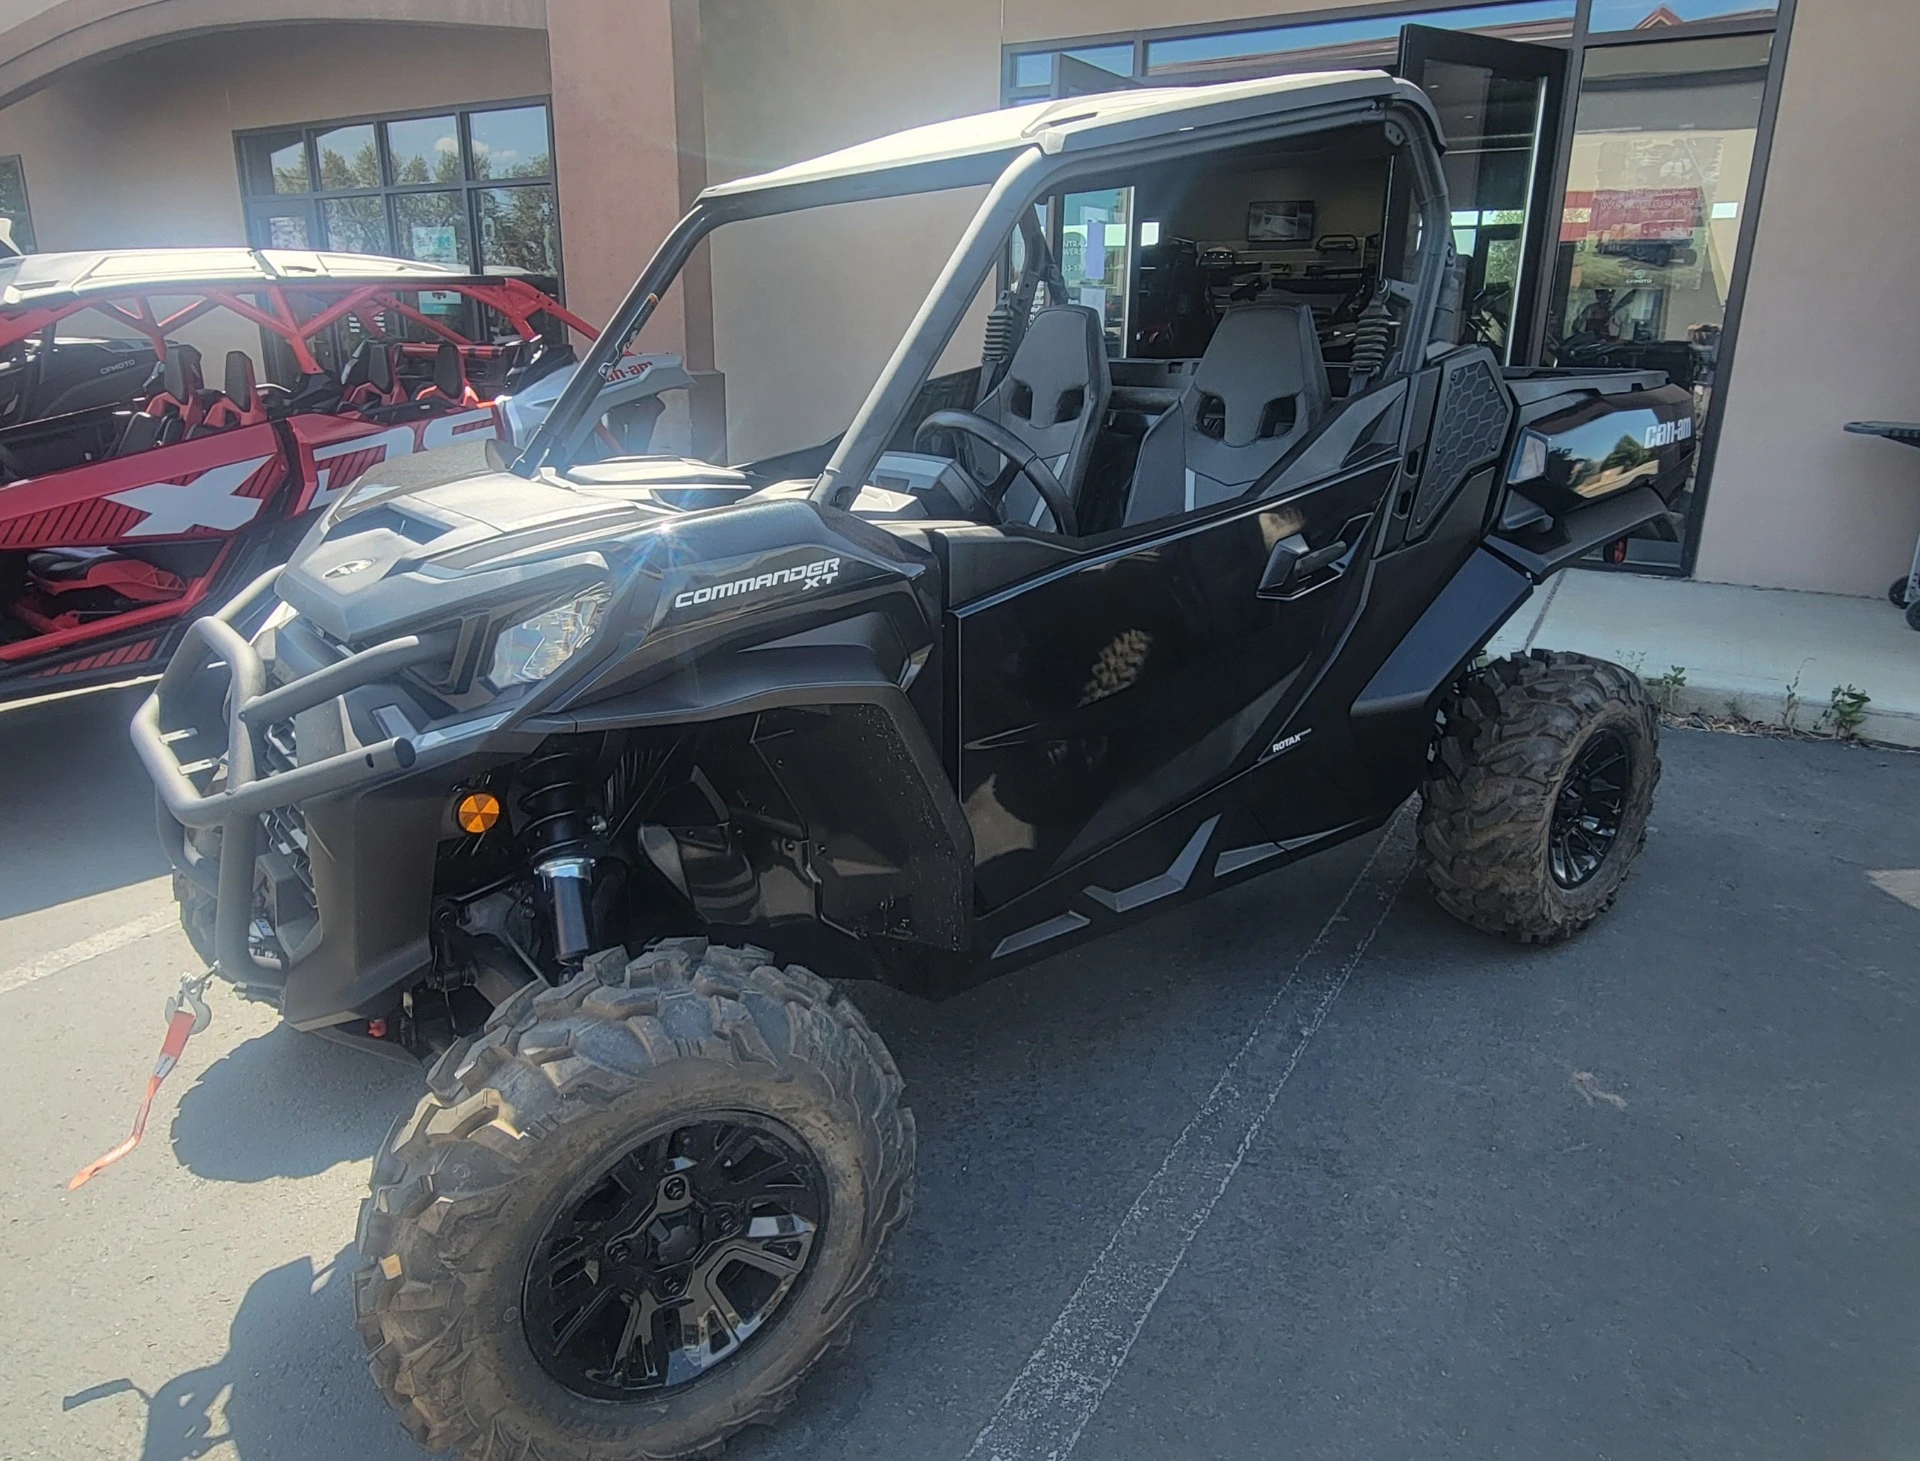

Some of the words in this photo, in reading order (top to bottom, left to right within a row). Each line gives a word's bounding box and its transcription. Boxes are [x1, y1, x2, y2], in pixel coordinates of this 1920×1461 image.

[100, 359, 135, 375] CFMOTO
[675, 557, 841, 608] COMMANDER
[802, 571, 839, 591] XT
[1272, 729, 1310, 753] ROTAX
